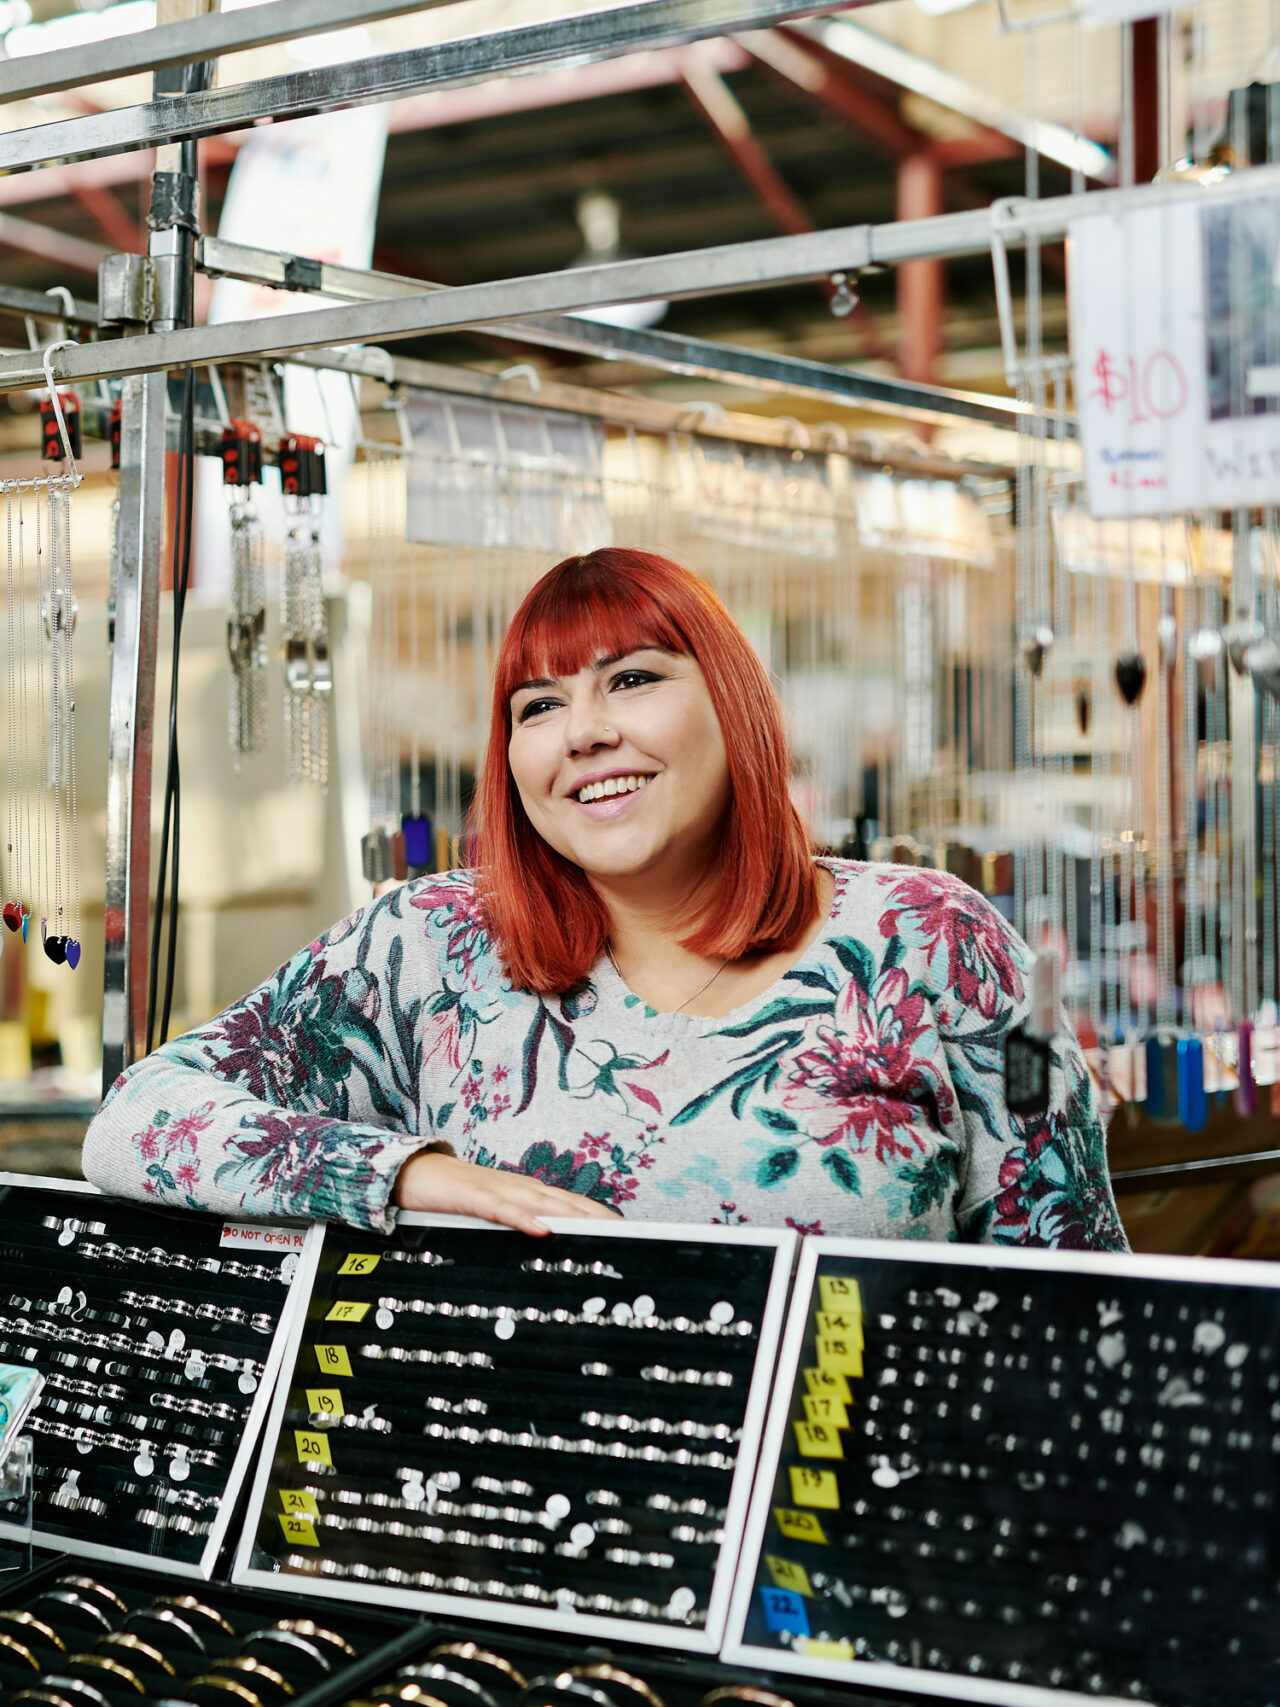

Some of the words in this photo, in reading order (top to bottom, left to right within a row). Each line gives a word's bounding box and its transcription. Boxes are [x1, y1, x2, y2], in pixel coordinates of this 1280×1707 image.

[1091, 348, 1188, 425] $10
[241, 1230, 261, 1241] NOT
[348, 1258, 368, 1271] 16
[336, 1306, 354, 1318] 17
[824, 1315, 849, 1330] 14
[324, 1346, 339, 1364] 18
[811, 1371, 836, 1388] 16
[318, 1395, 334, 1414] 19
[810, 1399, 831, 1416] 17
[301, 1438, 321, 1455] 20
[288, 1494, 305, 1509] 21
[287, 1521, 306, 1532] 22
